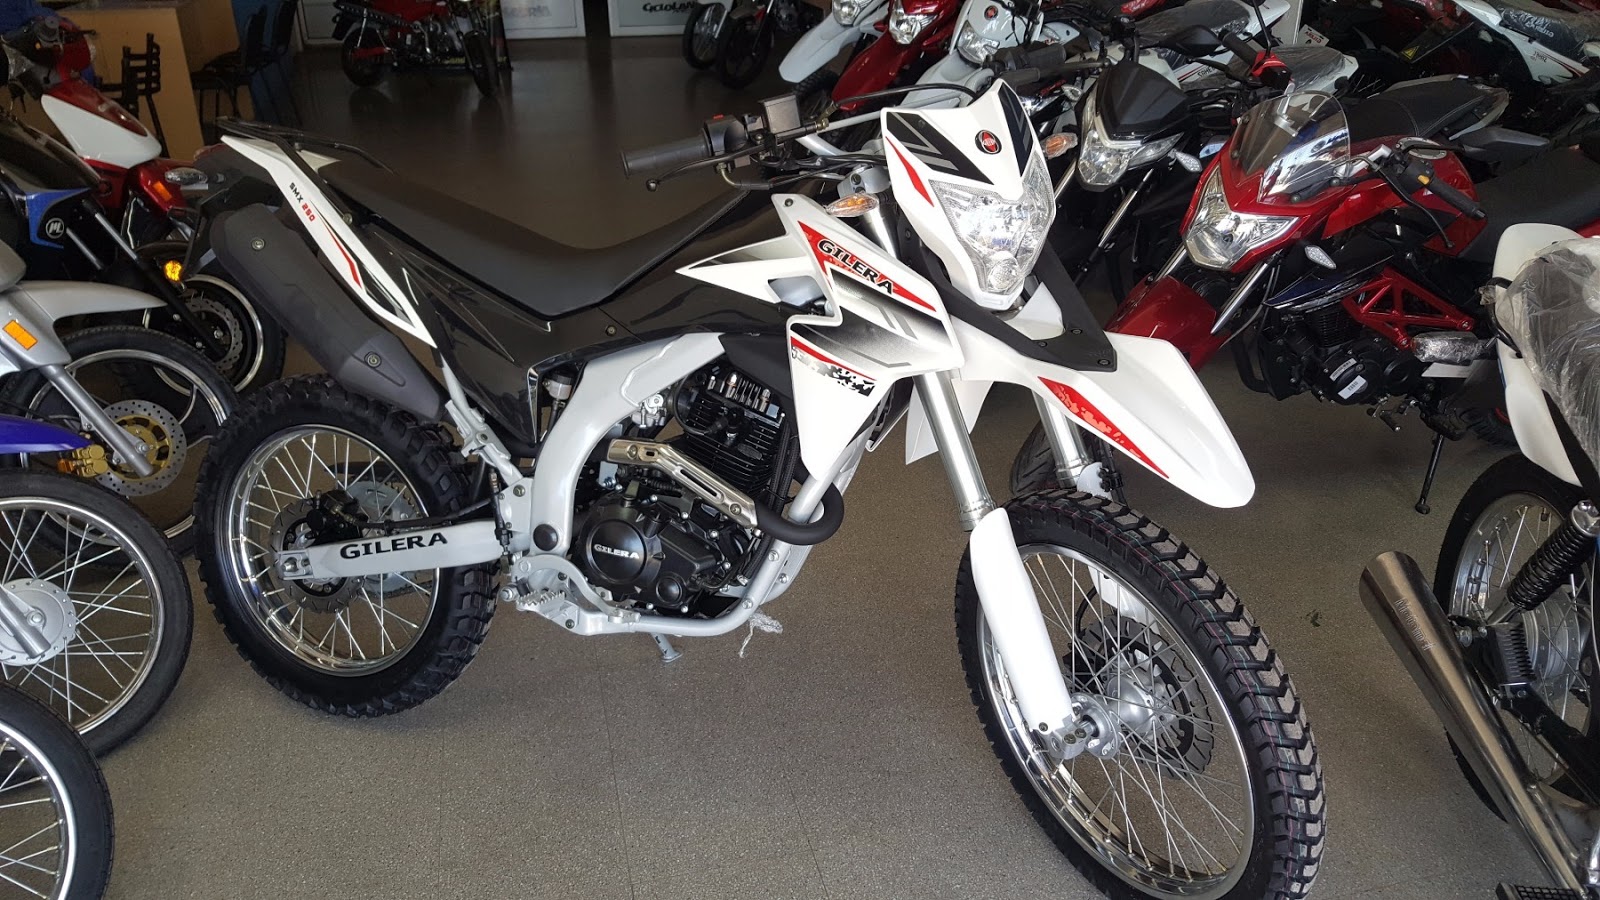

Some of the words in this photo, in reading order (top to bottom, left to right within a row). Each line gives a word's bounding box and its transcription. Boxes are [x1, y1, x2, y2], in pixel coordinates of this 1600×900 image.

[289, 182, 304, 203] SMX
[302, 202, 315, 222] 250
[818, 239, 893, 295] GILERA
[340, 532, 448, 559] GILERA
[593, 543, 640, 560] GILERA
